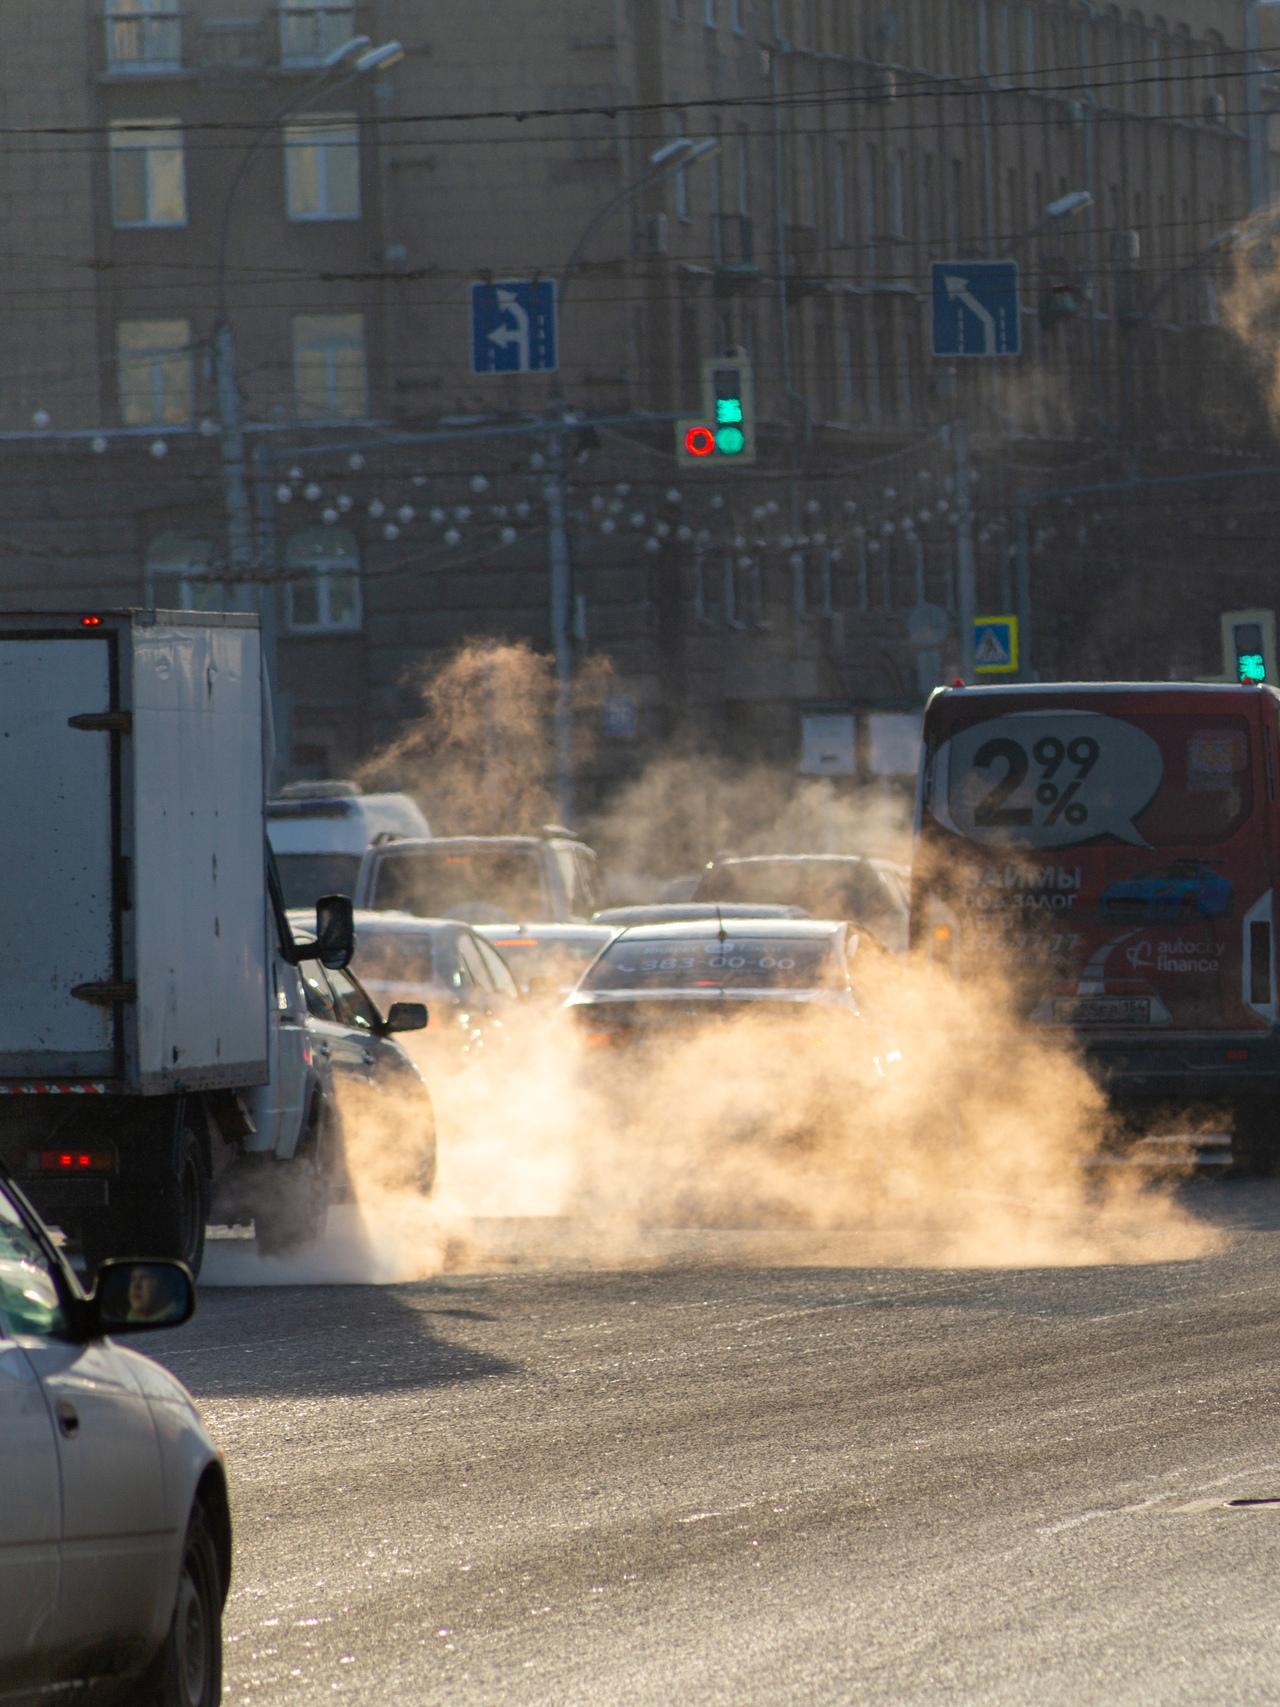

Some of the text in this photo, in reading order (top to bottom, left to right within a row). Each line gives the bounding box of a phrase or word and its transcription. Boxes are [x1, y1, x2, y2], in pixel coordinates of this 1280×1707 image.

[1013, 894, 1078, 909] ЗАЛОГ
[641, 956, 796, 972] 383-00-00
[1157, 955, 1219, 972] finance
